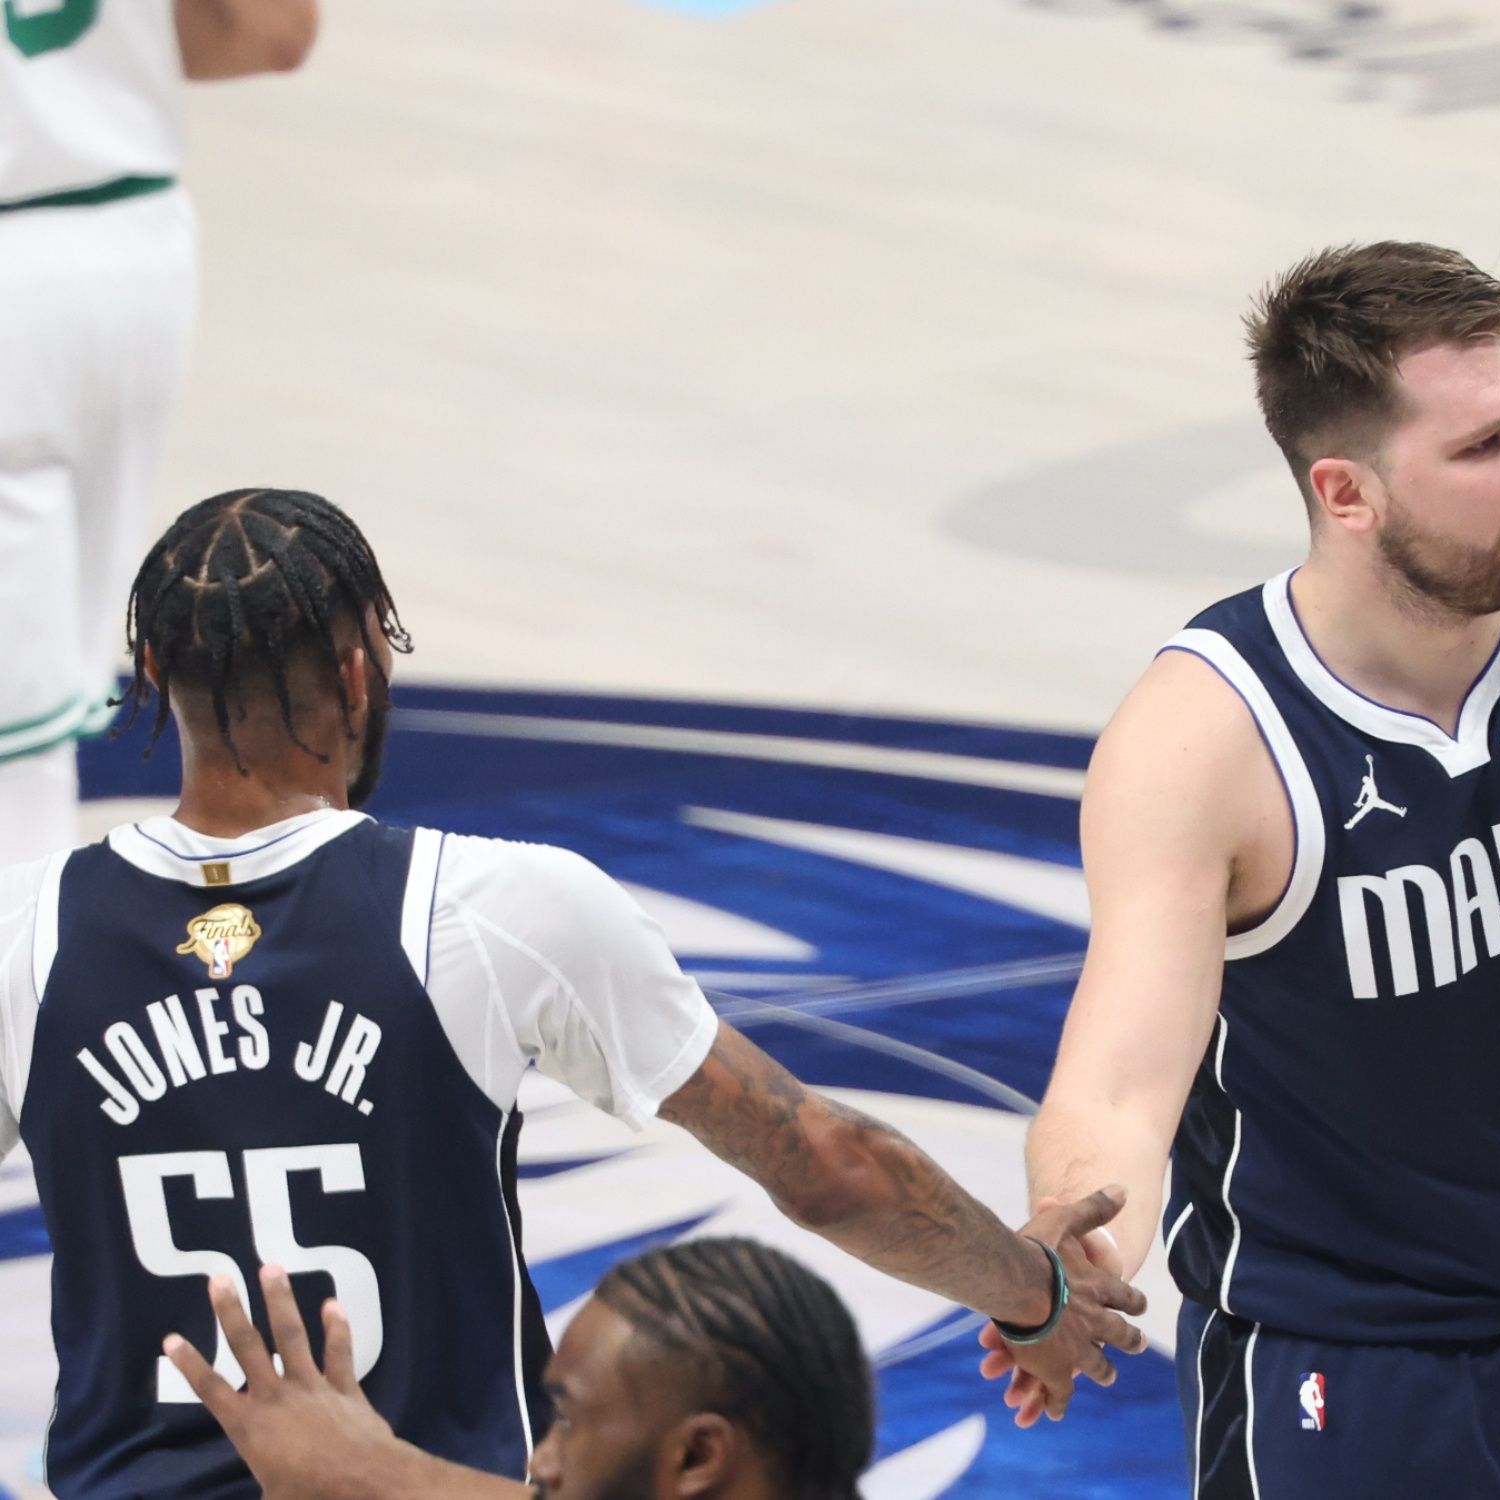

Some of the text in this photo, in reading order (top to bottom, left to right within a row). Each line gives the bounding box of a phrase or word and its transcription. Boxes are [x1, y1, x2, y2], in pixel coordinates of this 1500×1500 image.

[76, 984, 382, 1125] JONES JR.
[117, 1143, 383, 1404] 55
